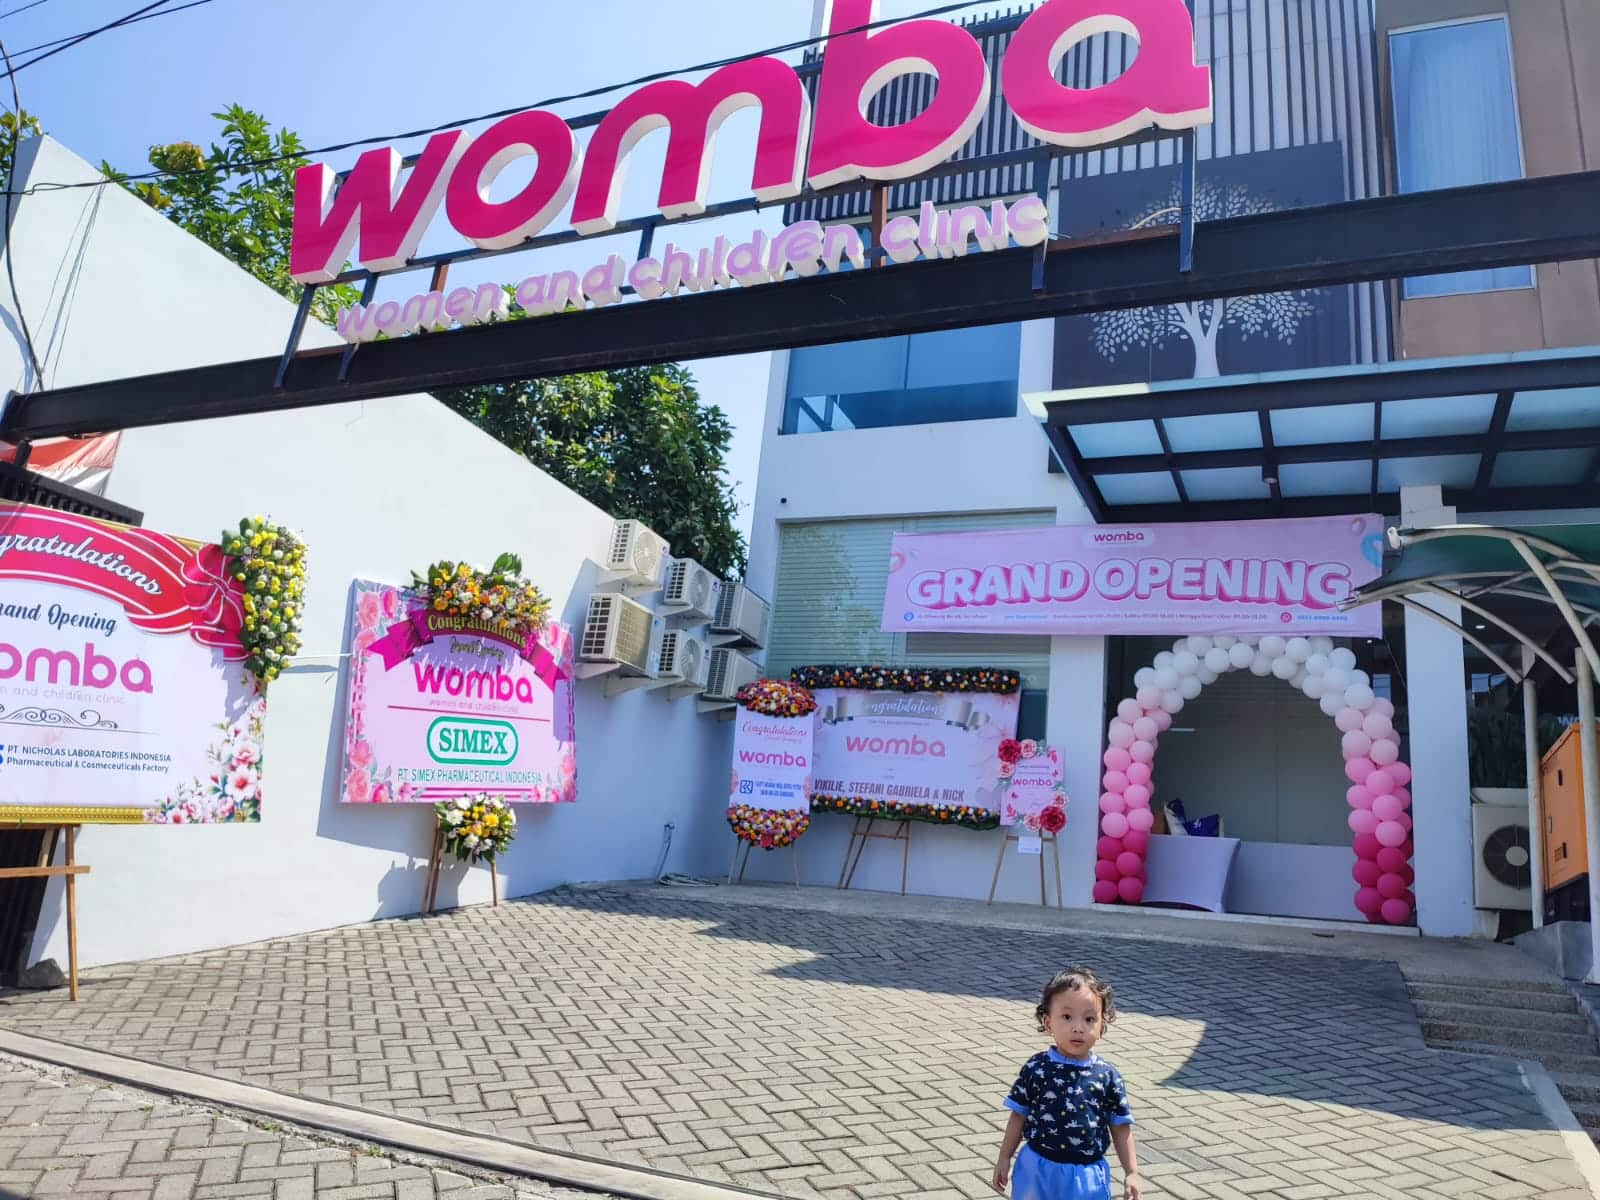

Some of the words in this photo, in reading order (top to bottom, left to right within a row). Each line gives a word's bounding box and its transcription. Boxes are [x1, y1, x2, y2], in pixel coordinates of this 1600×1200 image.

[289, 0, 1212, 284] womba
[336, 281, 510, 343] women
[515, 253, 626, 317] and
[628, 219, 865, 300] children
[880, 196, 1048, 264] clinic
[1094, 530, 1145, 543] womba
[906, 560, 1091, 610] GRAND
[1093, 557, 1352, 610] OPENING
[47, 603, 118, 637] Opening
[413, 663, 534, 705] womba
[438, 727, 508, 754] SIMEX
[846, 734, 946, 757] womba
[22, 744, 66, 757] NICHOLAS
[67, 748, 129, 760] LABORATORIES
[130, 752, 172, 762] INDONESIA
[739, 749, 807, 767] womba
[6, 756, 73, 768] Pharmaceutical
[81, 760, 141, 771] Cosmeceuticals
[142, 764, 169, 774] Factory
[411, 768, 435, 782] SIMEX
[437, 768, 504, 783] PHARMACEUTICAL
[506, 771, 542, 784] INDONESIA
[1012, 777, 1052, 786] womba
[848, 781, 885, 796] STEFANI
[886, 784, 930, 799] GABRIELA
